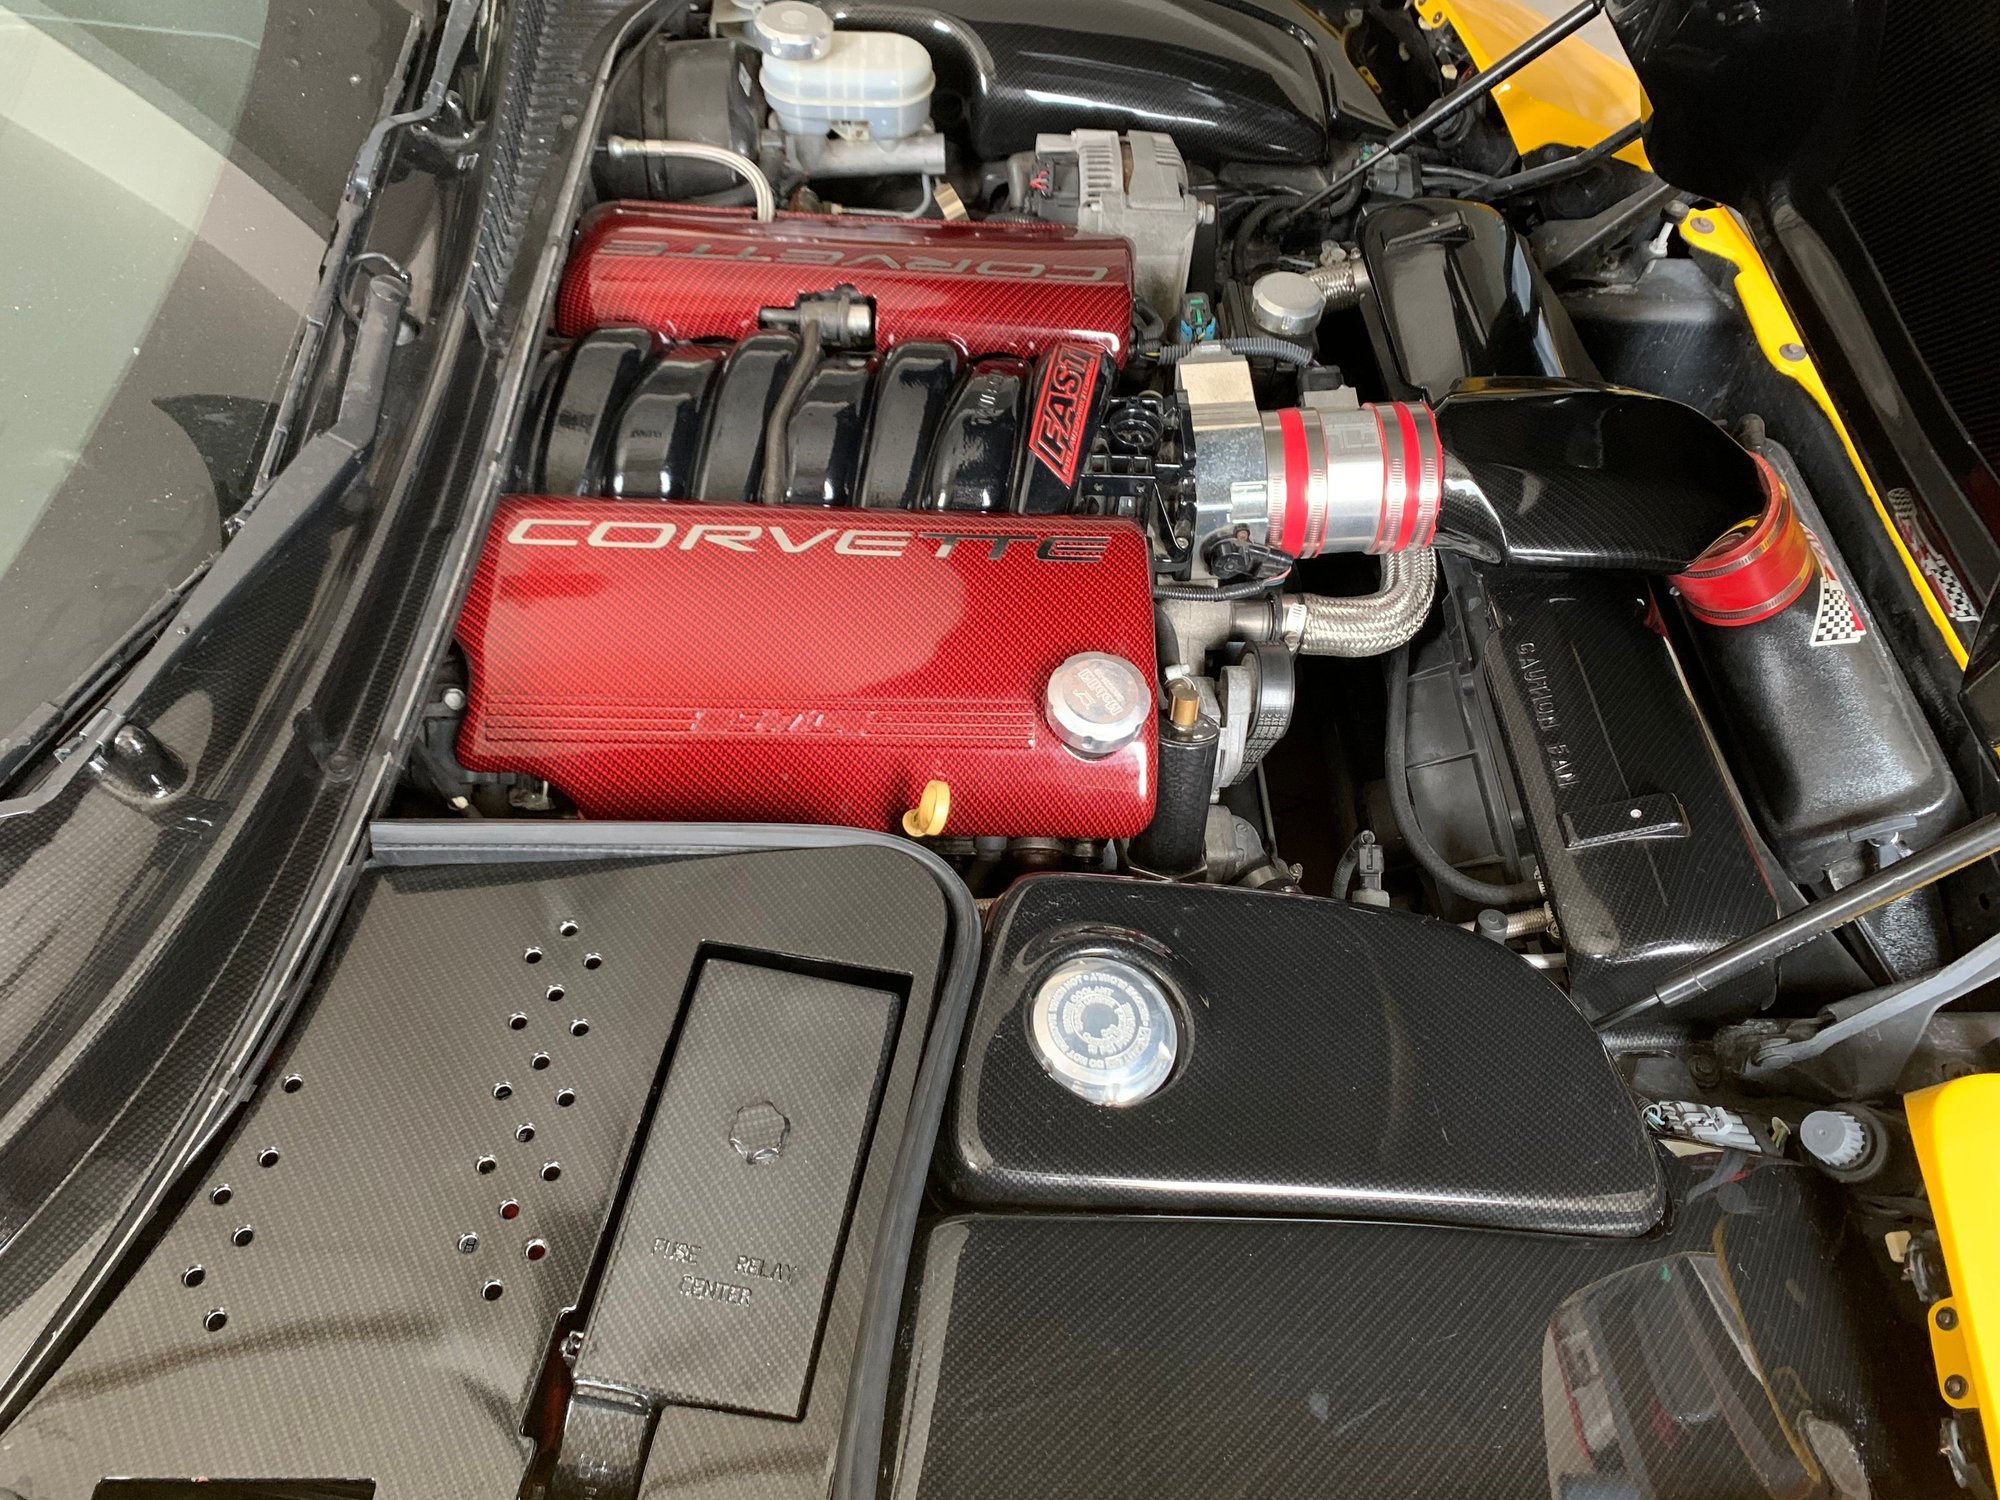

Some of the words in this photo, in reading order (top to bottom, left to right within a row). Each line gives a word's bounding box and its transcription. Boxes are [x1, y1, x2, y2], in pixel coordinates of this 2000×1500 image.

[598, 239, 1109, 283] CORVETTE
[1038, 345, 1088, 465] FAST
[507, 518, 1111, 562] CORVETTE
[1086, 676, 1124, 716] Mobil
[1519, 642, 1561, 730] CAUTION
[1547, 744, 1581, 788] FAN
[651, 1237, 702, 1265] FUSE
[735, 1255, 798, 1285] RELAY
[679, 1273, 753, 1307] CENTER
